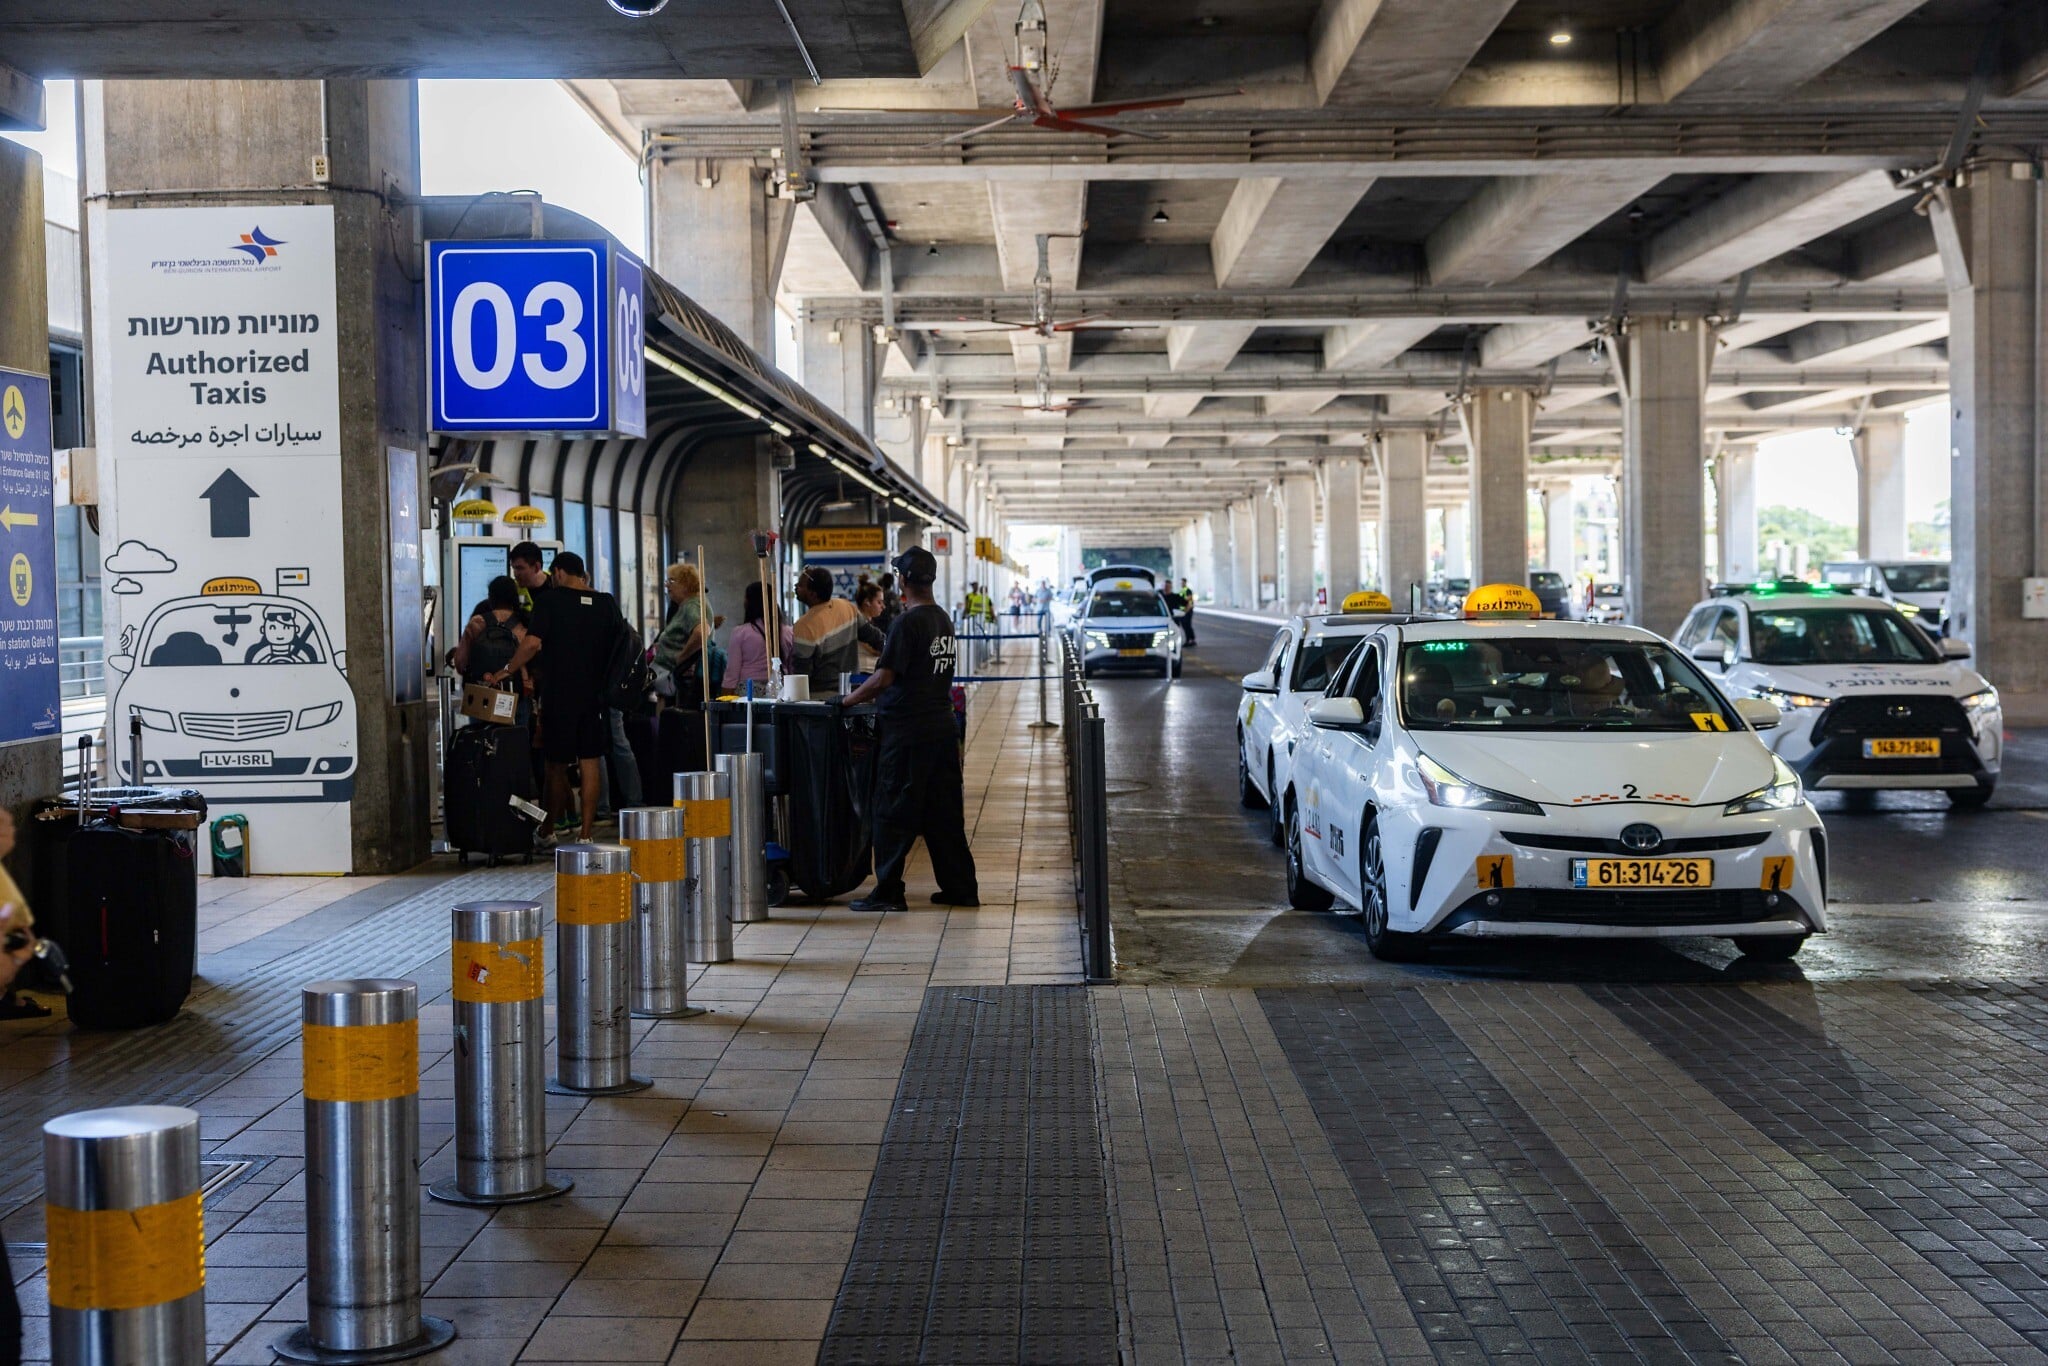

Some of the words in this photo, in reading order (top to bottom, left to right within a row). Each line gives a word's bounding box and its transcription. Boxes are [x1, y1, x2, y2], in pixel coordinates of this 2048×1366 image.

[128, 315, 230, 337] מורשות
[238, 314, 320, 335] מוניות
[451, 281, 587, 390] 03
[618, 286, 642, 396] 03
[146, 349, 309, 375] Authorized
[190, 380, 267, 405] Taxis
[255, 423, 322, 447] سيارات
[2, 465, 24, 478] Entrance
[207, 581, 228, 593] taxi
[1477, 597, 1503, 611] taxi
[1504, 600, 1533, 611] מונית
[0, 620, 15, 633] שער
[16, 619, 34, 631] רכבת
[36, 619, 53, 630] תחנת
[8, 636, 30, 650] station
[31, 635, 46, 648] Gate
[46, 635, 54, 647] 01
[1426, 642, 1464, 651] TAXI
[204, 754, 270, 766] I-LV-ISRL
[1622, 783, 1642, 799] 2
[1576, 868, 1585, 879] IL
